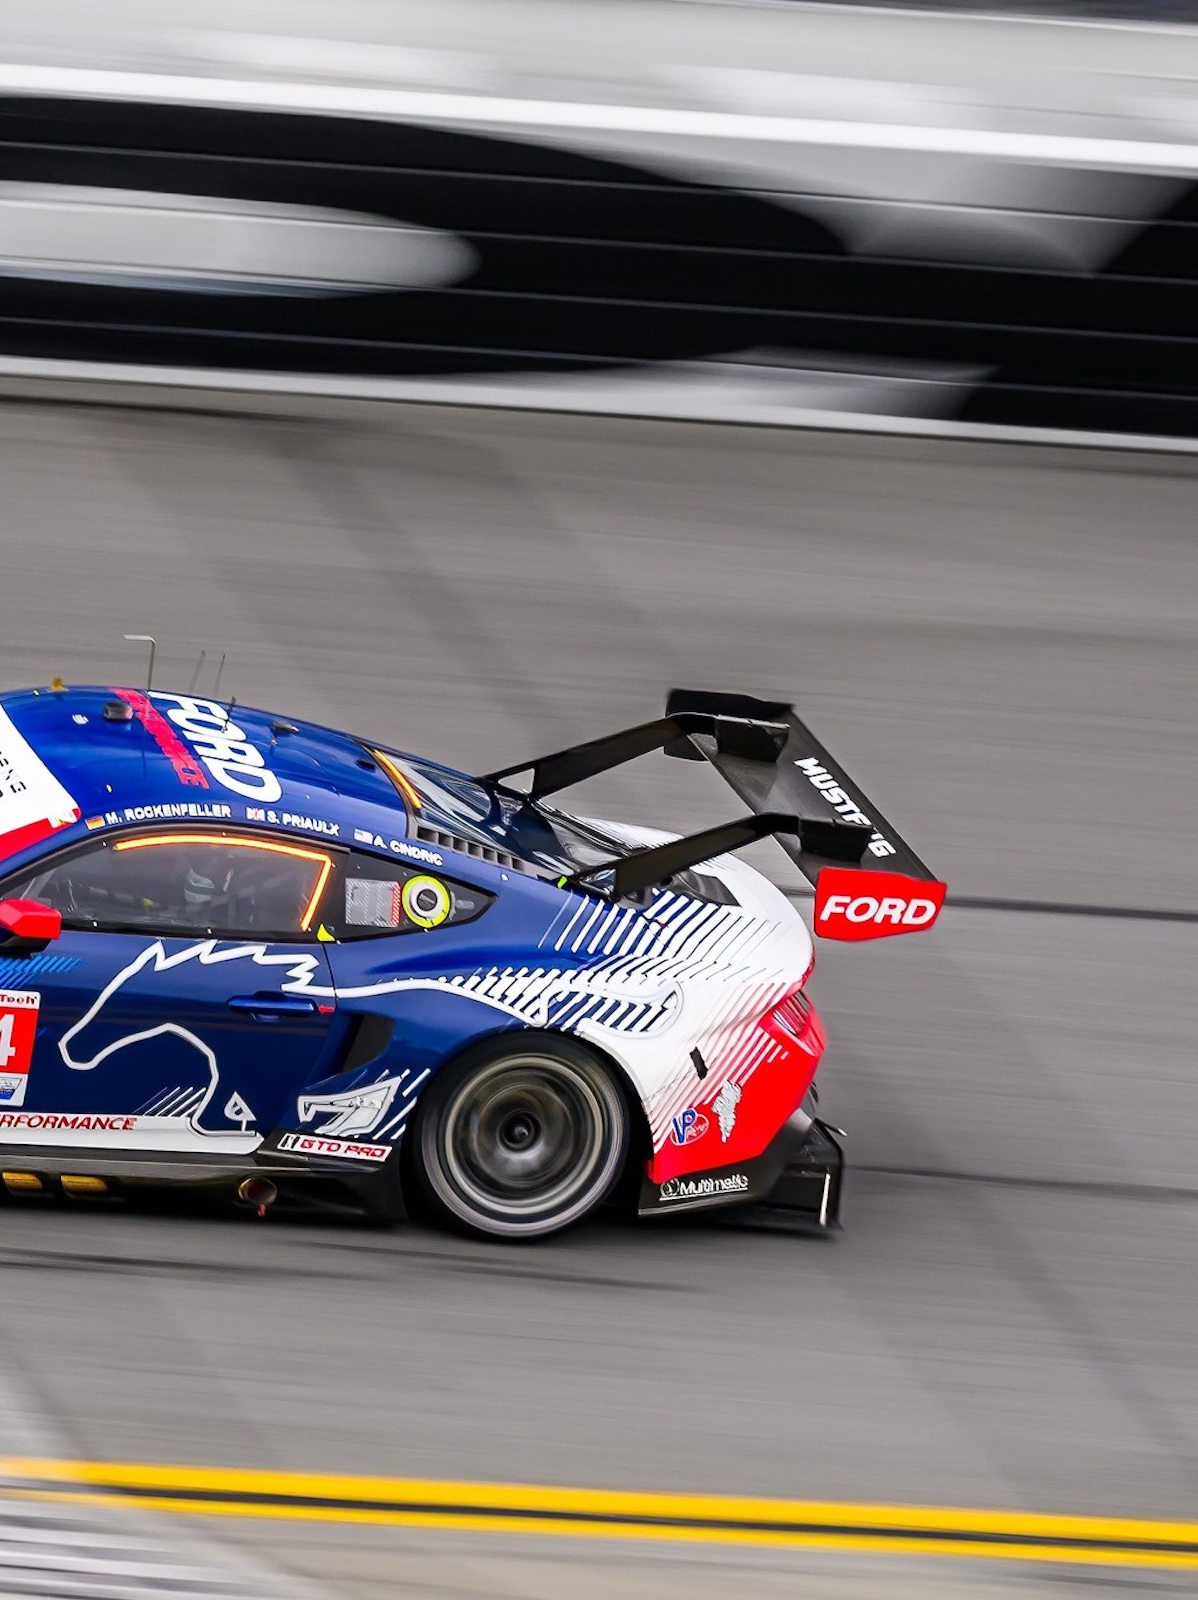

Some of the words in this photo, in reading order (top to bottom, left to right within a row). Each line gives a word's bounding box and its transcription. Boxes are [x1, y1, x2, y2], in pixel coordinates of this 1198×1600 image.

[146, 689, 283, 803] FORD
[105, 813, 123, 825] M.
[124, 804, 231, 821] ROCKENFELLER
[267, 810, 280, 825] S.
[283, 812, 340, 836] PRIAULX
[373, 834, 388, 850] A.
[390, 839, 443, 866] CINDRIC
[820, 895, 937, 925] FORD
[300, 1138, 342, 1153] GTD
[344, 1143, 387, 1159] PRO
